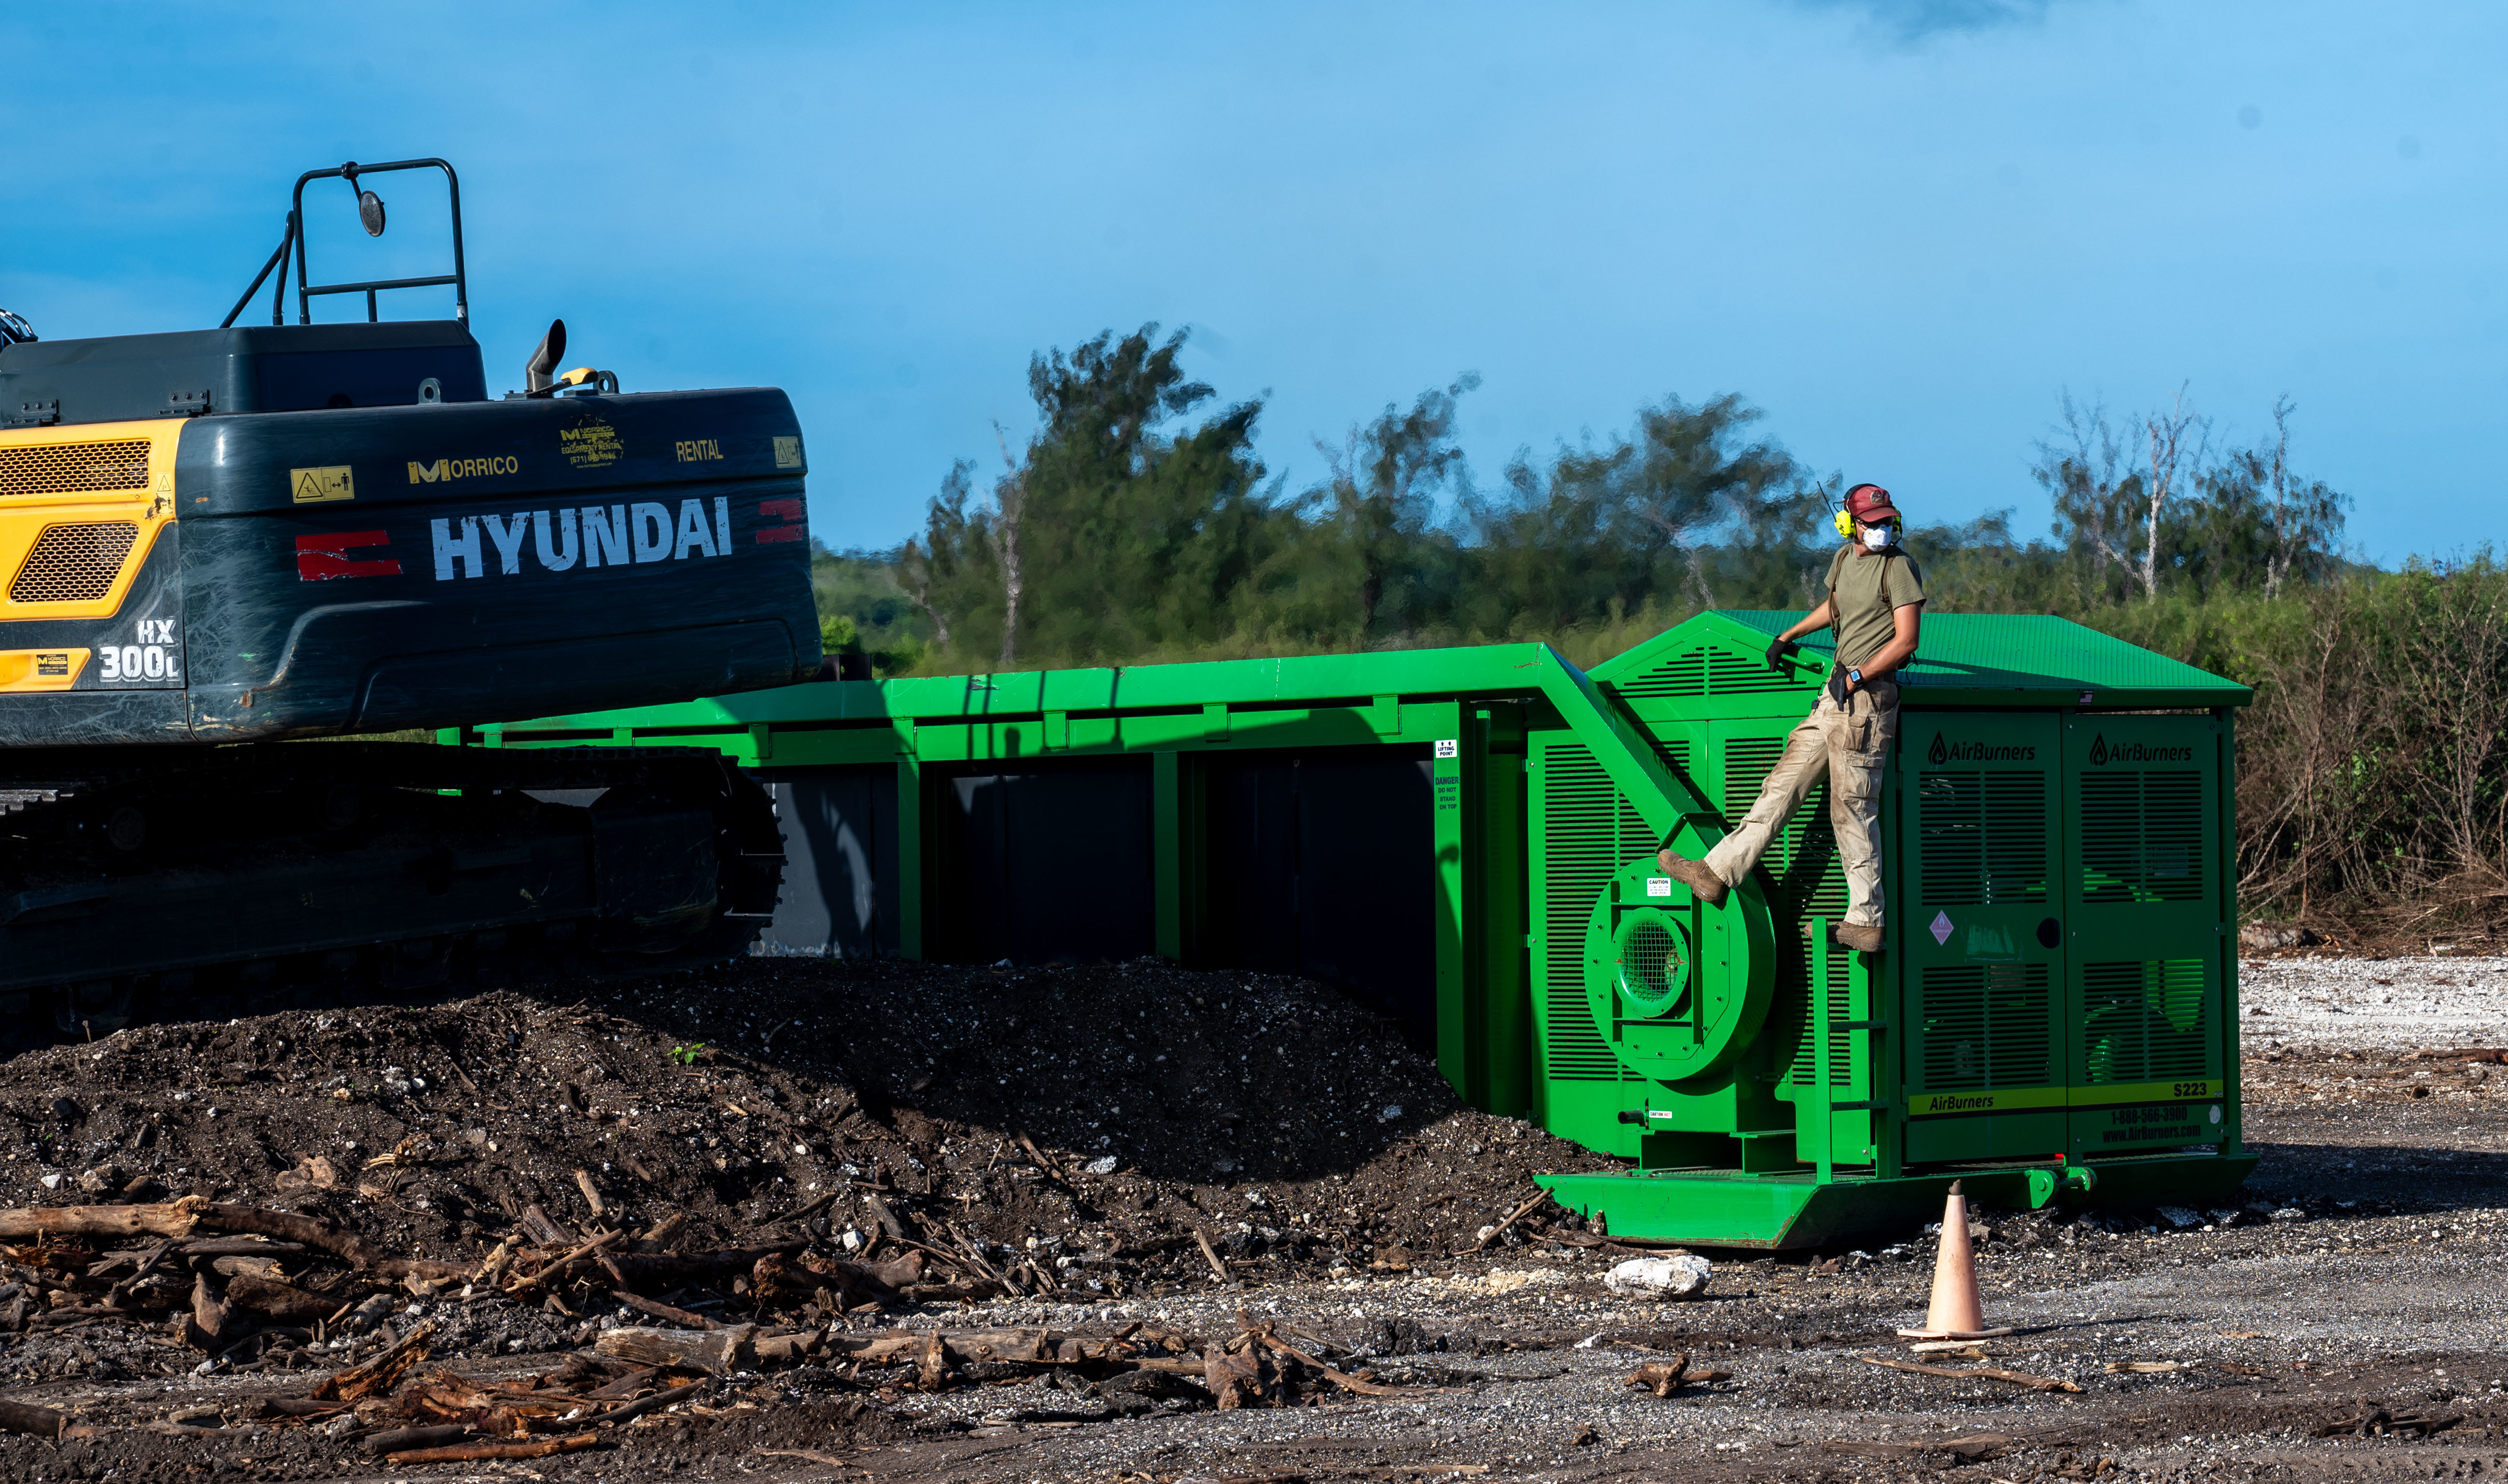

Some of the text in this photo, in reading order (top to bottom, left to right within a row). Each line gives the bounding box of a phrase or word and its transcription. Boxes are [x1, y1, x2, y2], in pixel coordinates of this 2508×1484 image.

[570, 456, 587, 464] (671)
[676, 439, 724, 462] RENTAL
[407, 456, 518, 484] MORRICO
[431, 497, 732, 581] HYUNDAI
[138, 620, 174, 644] HX
[100, 645, 179, 678] 300L
[1948, 741, 2035, 761] AirBurners
[2109, 743, 2191, 762] AirBurners
[1435, 776, 1459, 785] DANGER
[2174, 1082, 2207, 1097] S223
[1929, 1096, 1994, 1111] AirBurners
[2111, 1106, 2188, 1125] 1-888-566-3900
[2103, 1124, 2201, 1143] www.AirBurners.com
